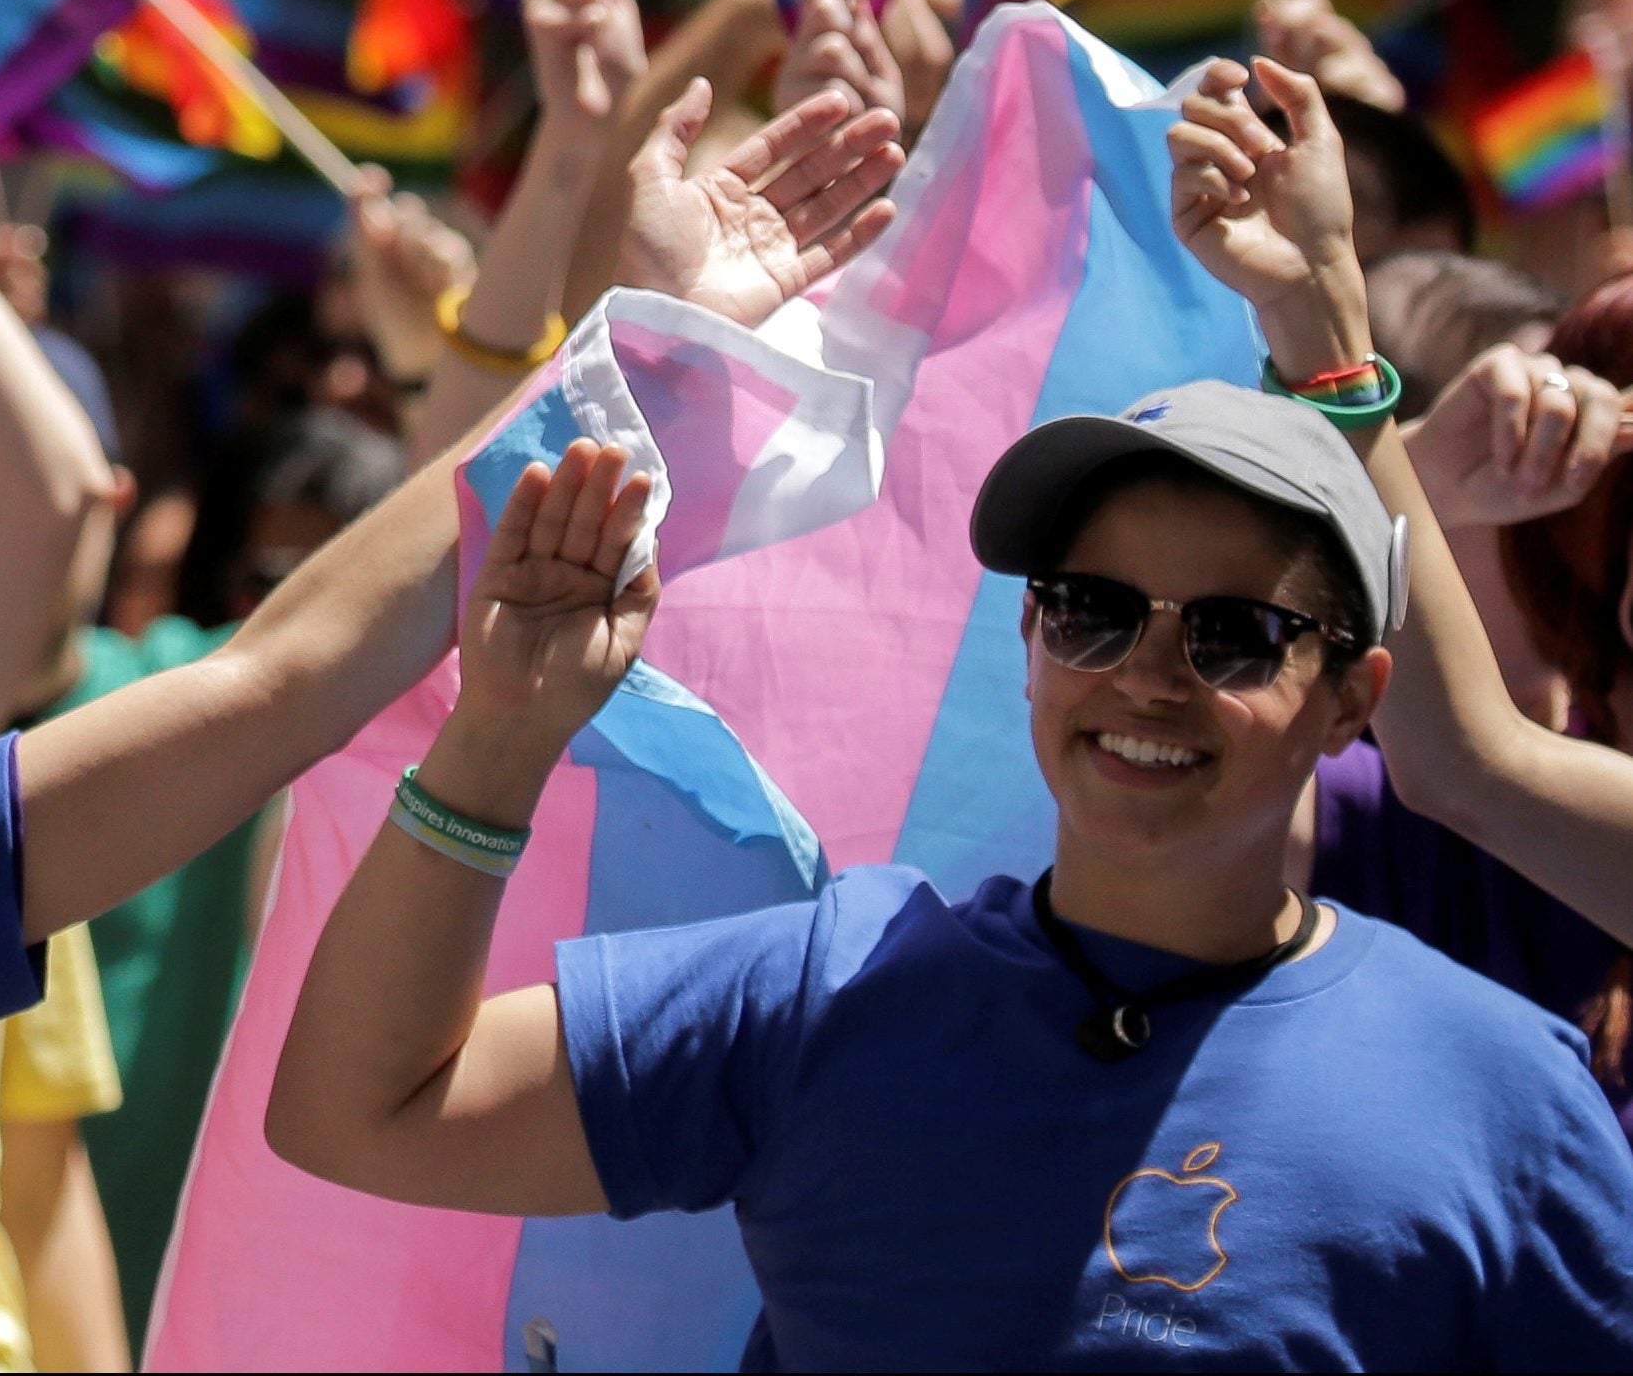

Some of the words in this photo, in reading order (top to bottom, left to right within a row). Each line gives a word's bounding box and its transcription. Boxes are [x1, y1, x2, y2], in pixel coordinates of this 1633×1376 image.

[399, 784, 444, 829] inspires
[446, 818, 521, 852] innovation
[1097, 1292, 1197, 1348] Pride
